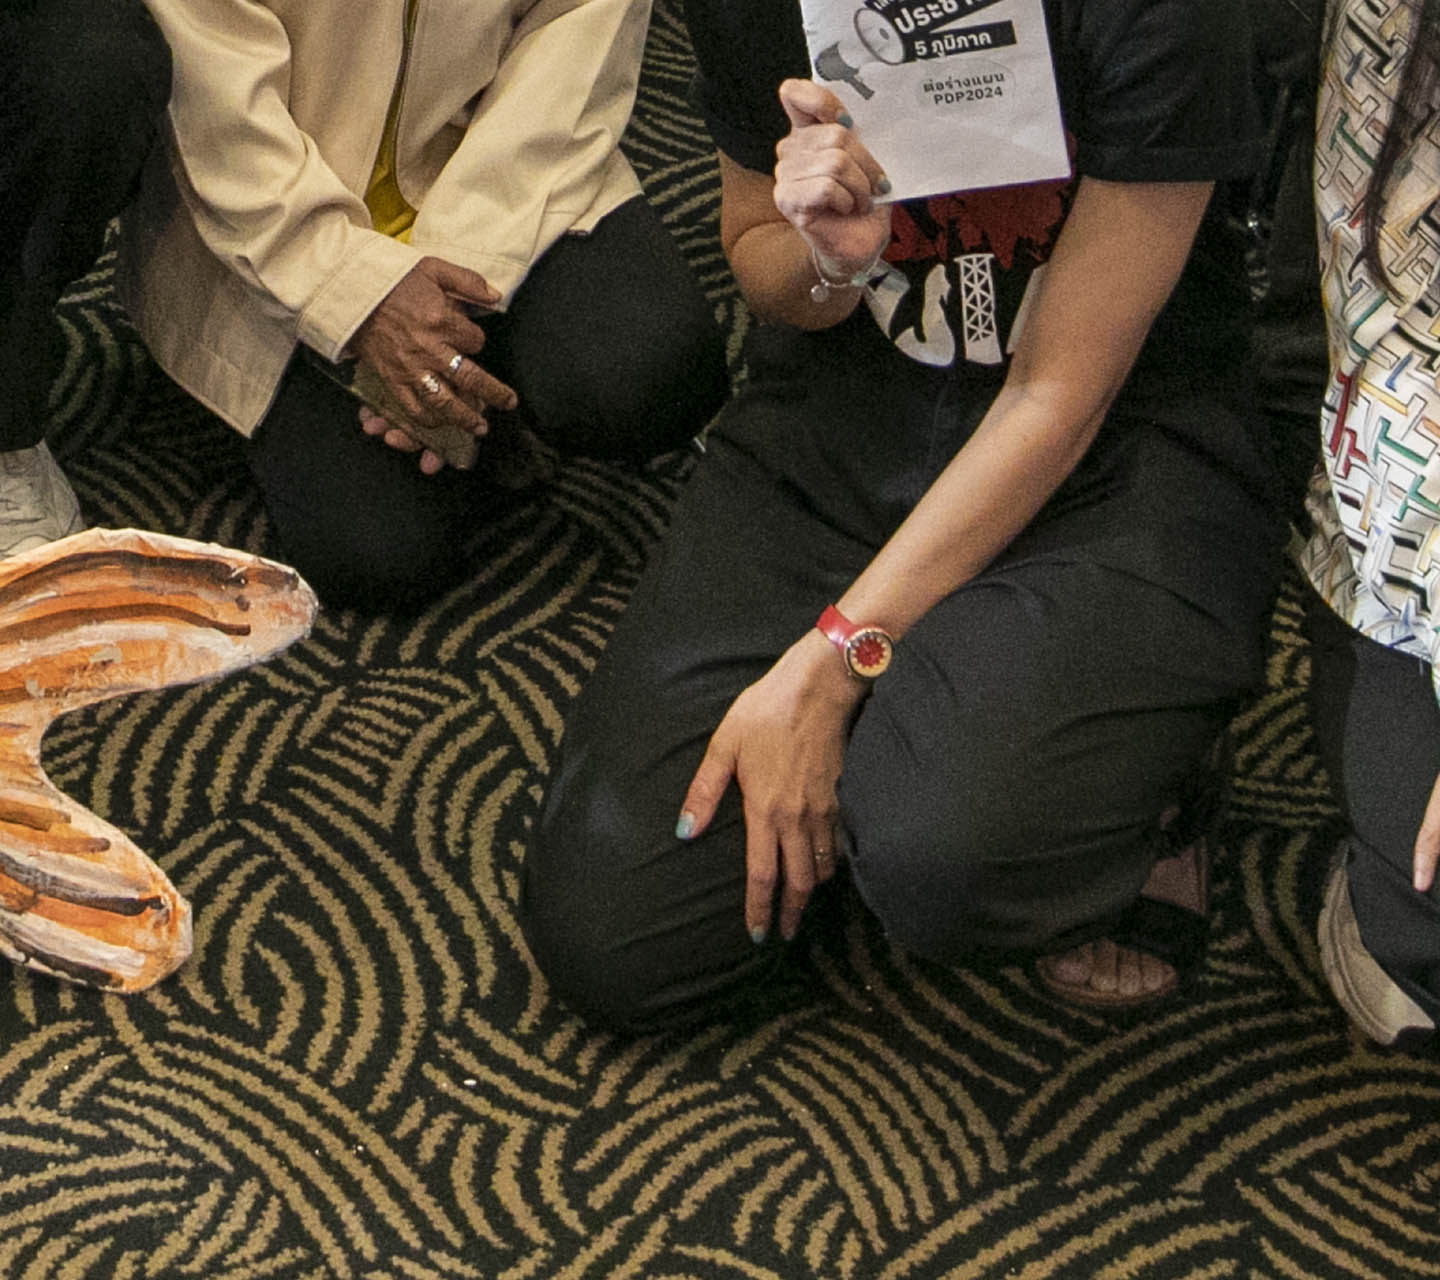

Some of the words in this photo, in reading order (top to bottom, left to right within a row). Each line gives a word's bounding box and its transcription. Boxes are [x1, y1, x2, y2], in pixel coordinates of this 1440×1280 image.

[931, 31, 992, 57] ภูมิภาค
[923, 71, 1006, 94] ต่อร่างแผน
[934, 85, 1003, 106] PDP2024
